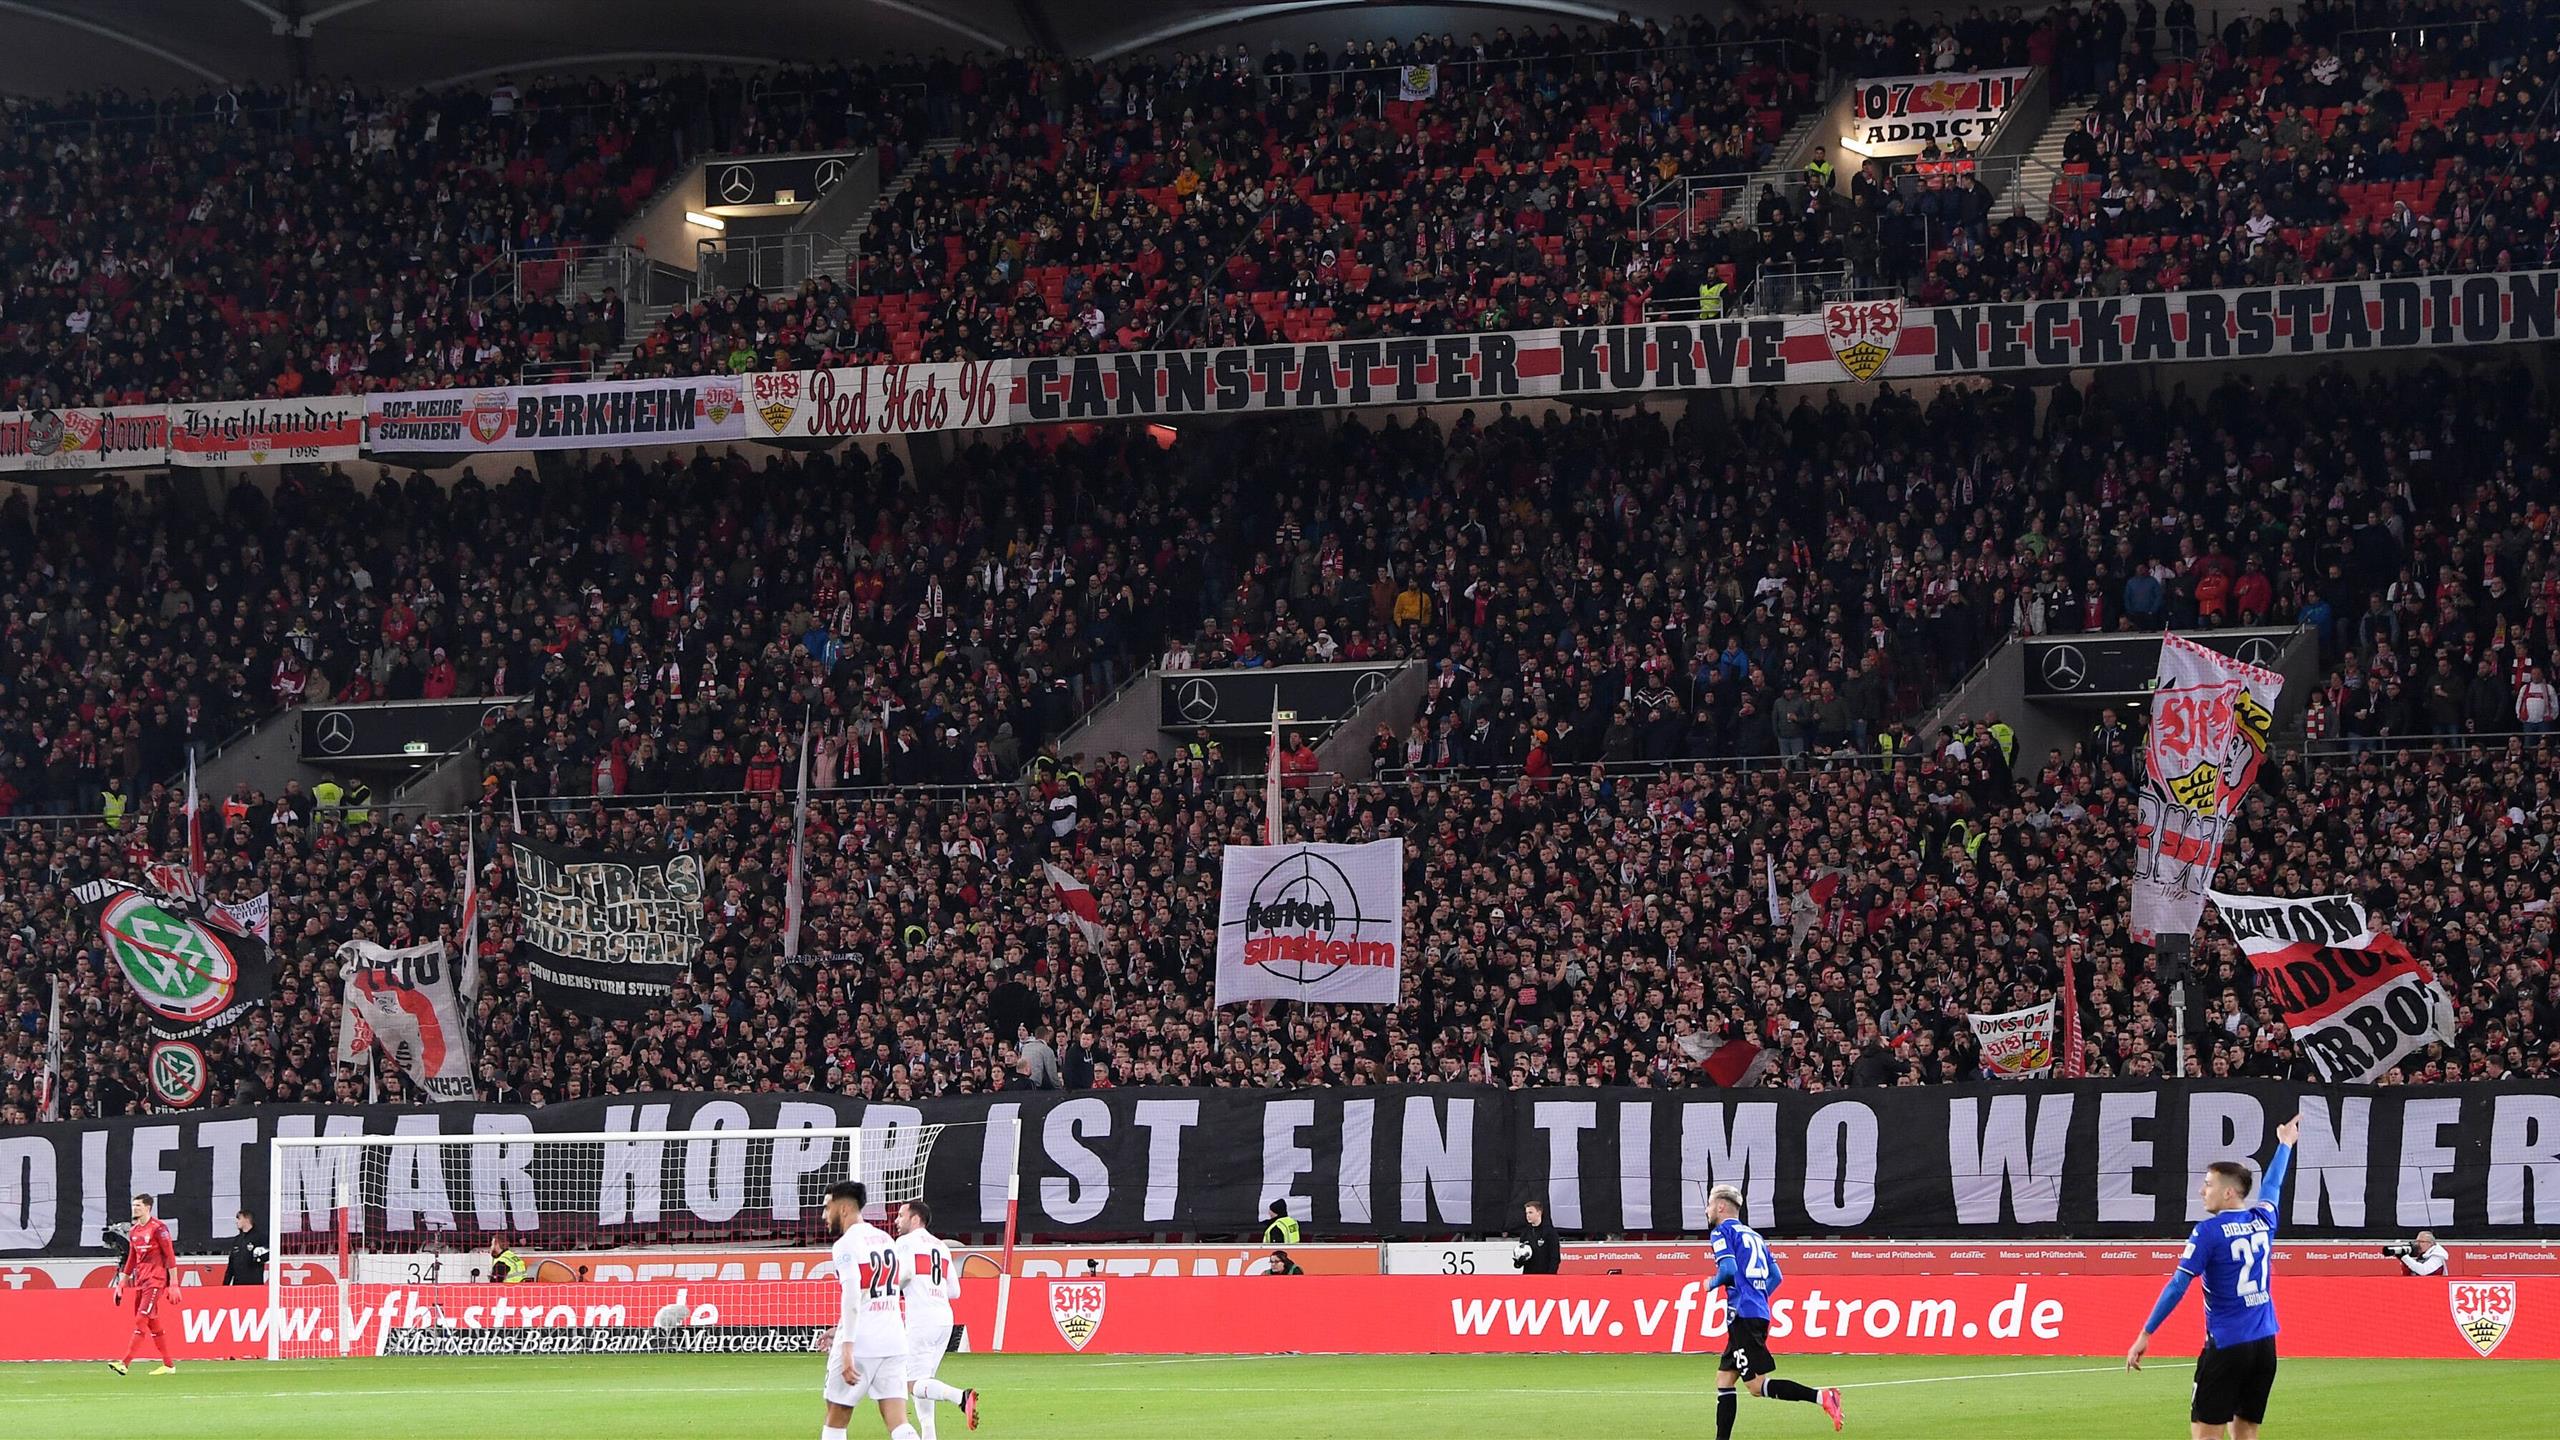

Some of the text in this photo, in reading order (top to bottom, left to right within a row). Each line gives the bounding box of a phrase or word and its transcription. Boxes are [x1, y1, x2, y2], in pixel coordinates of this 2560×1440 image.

[1865, 77, 2013, 119] 07 11
[1866, 118, 2000, 144] ADDICT
[1934, 273, 2559, 372] NECKARSTADION
[1027, 321, 1785, 420] CANNSTATTER KURVE
[515, 388, 697, 438] BERKHEIM
[808, 360, 996, 437] Red Hots 96
[184, 406, 348, 444] Highlander
[380, 423, 462, 440] SCHWABEN
[512, 843, 702, 906] ULTRAS
[518, 883, 704, 936] BEDEUTET
[1243, 929, 1396, 968] sinsheim
[528, 961, 626, 995] CHWABENSTURM
[0, 1091, 2560, 1250] DIETMAR HOPP IST EIN TIMO WERNER
[870, 1249, 897, 1299] 22
[931, 1248, 942, 1286] 8
[1442, 1251, 1476, 1275] 35
[1742, 1233, 1769, 1280] 25
[1876, 1250, 1890, 1259] und
[2025, 1250, 2039, 1259] und
[2230, 1231, 2270, 1297] 27
[2333, 1251, 2347, 1260] und
[2492, 1251, 2507, 1260] und
[1451, 1283, 2064, 1353] www.vfbstrom.de
[590, 1328, 654, 1352] Bank
[1733, 1348, 1749, 1369] 25
